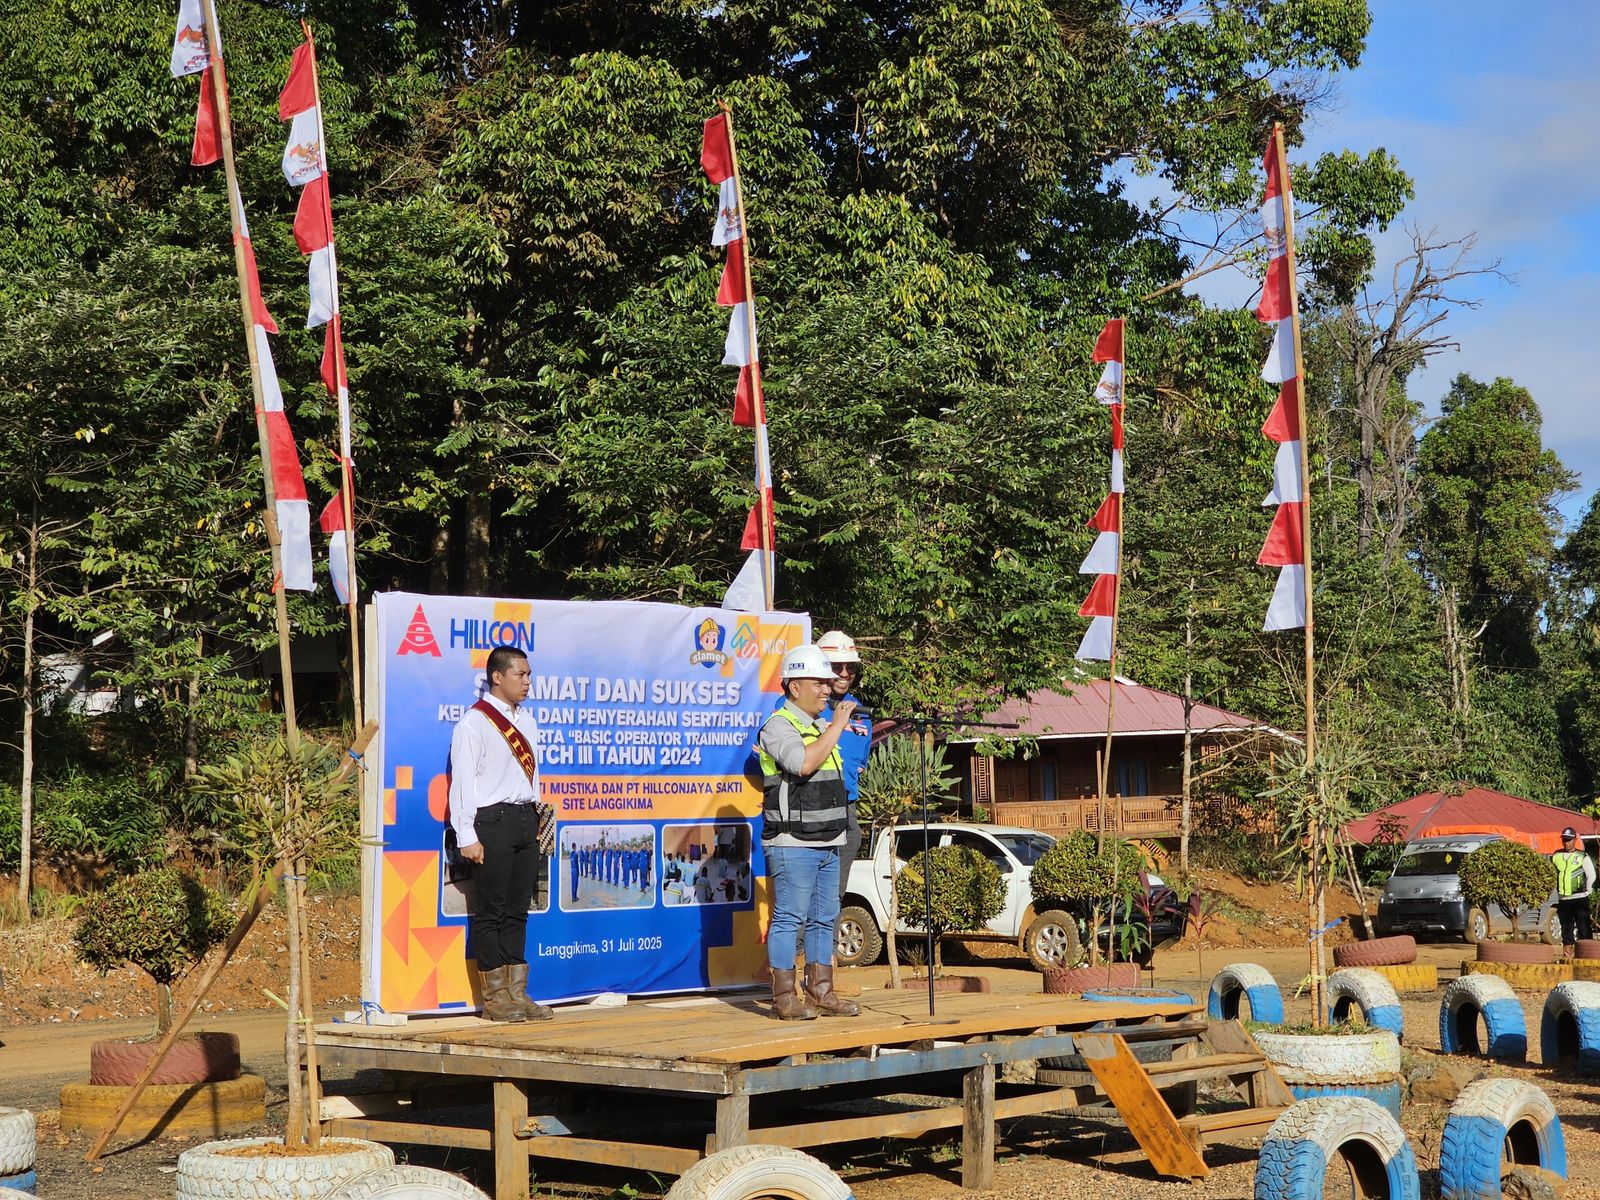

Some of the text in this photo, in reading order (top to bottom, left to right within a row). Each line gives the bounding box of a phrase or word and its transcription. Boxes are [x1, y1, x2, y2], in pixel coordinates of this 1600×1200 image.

[450, 618, 535, 652] HILLCON
[472, 673, 741, 705] SAMAT DAN SUKSES
[538, 707, 575, 724] DAN
[578, 708, 678, 727] PENYERAHAN
[681, 711, 762, 728] SERTIFIKAT
[615, 731, 682, 746] OPERATOR
[537, 745, 701, 765] TCH III TAHUN 2024
[550, 782, 598, 795] MUSTIKA
[601, 782, 623, 795] DAN
[626, 782, 640, 795] PT
[643, 781, 713, 795] HILLCONJAYA
[716, 781, 742, 794] SAKTI
[562, 797, 653, 811] SITE LANGGIKIMA
[538, 936, 662, 959] Langgikima, 31 Juli 2025
